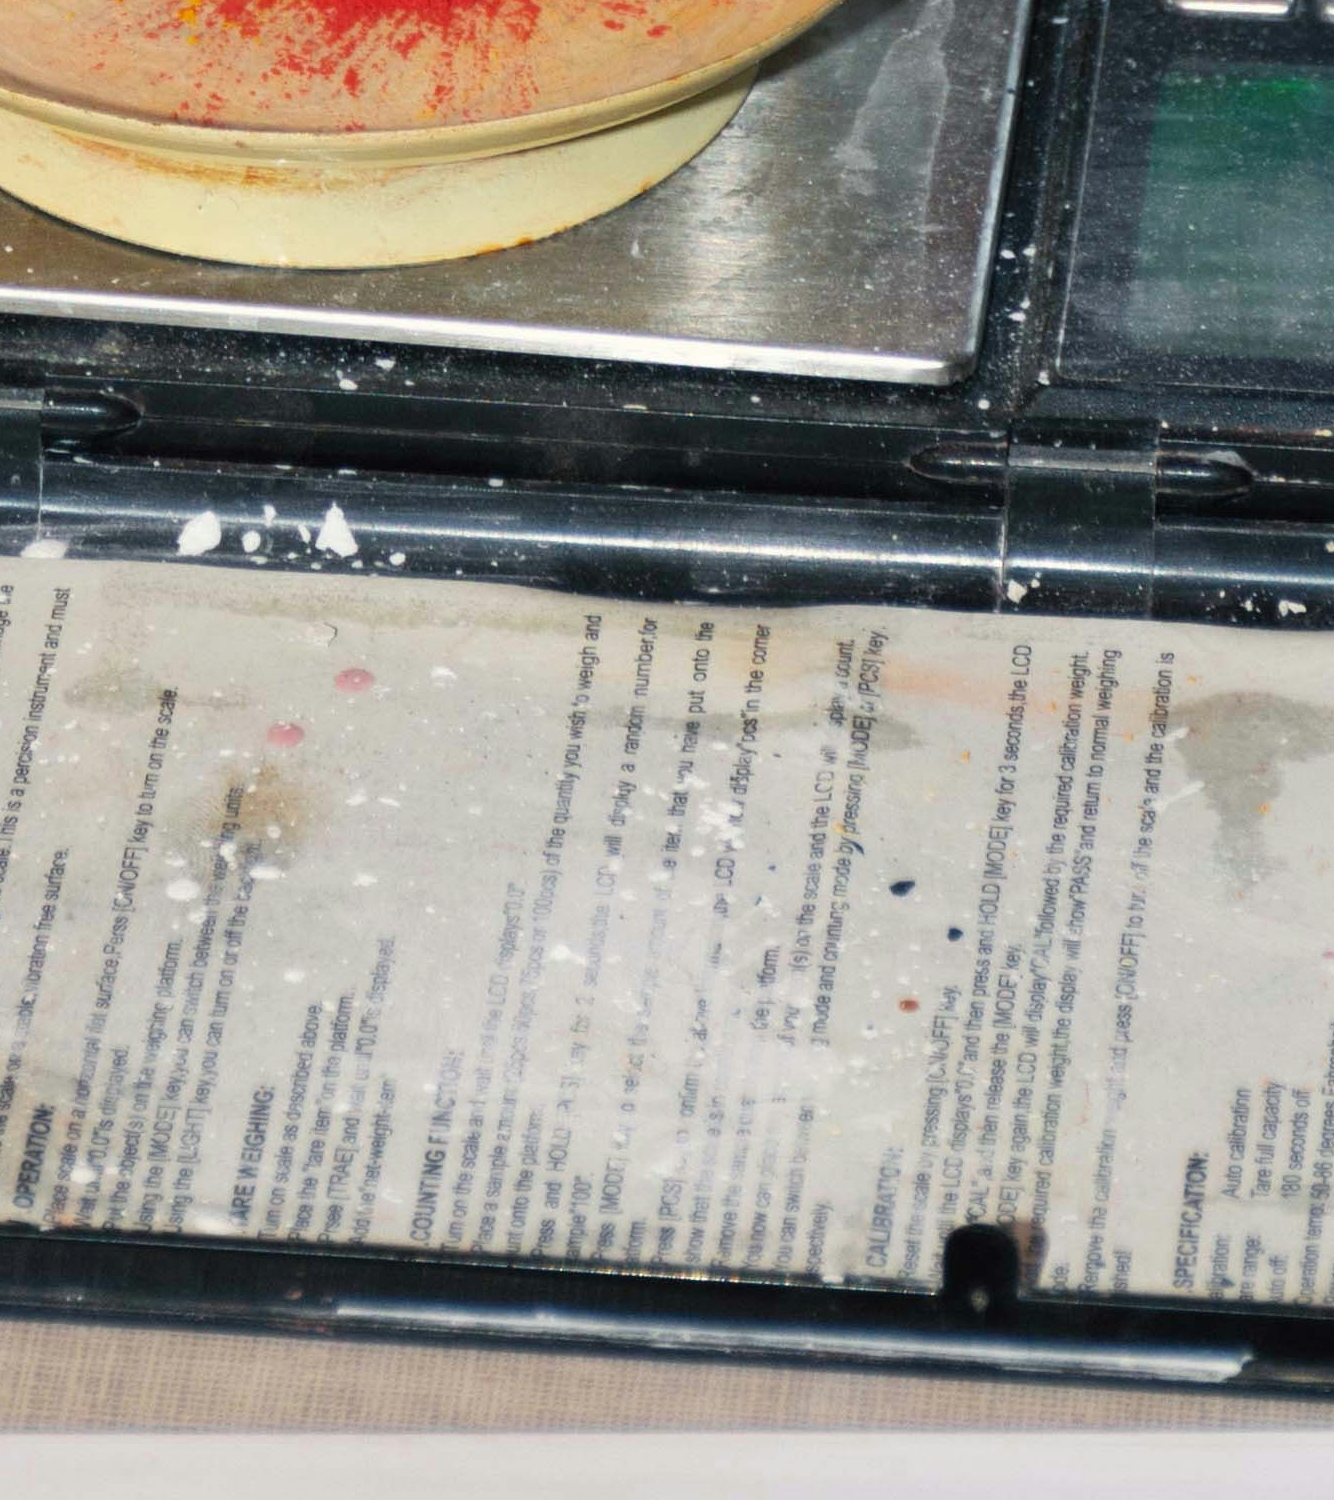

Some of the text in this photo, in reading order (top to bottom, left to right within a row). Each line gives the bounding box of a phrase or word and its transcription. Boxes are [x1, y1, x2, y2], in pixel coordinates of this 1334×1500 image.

[42, 623, 62, 649] and
[49, 587, 70, 620] must
[686, 648, 710, 713] put onto
[744, 624, 770, 693] the corner
[1096, 649, 1122, 710] weighing
[11, 725, 41, 784] percision
[545, 614, 602, 848] the quantity you wish weigh and
[621, 705, 643, 754] random
[1090, 715, 1109, 760] normal
[128, 727, 169, 843] key turn on the
[1082, 781, 1100, 820] return
[1086, 764, 1103, 777] to
[795, 805, 830, 925] the scale and the
[964, 644, 1032, 1030] then press HOLD [MODE] key for LCD
[830, 857, 850, 896] mode
[1017, 703, 1081, 1083] LCD will the required calibration
[33, 904, 56, 930] free
[1093, 651, 1175, 1201] calibration and the calibration is
[919, 1086, 947, 1146] pressing
[979, 1032, 1010, 1145] then release the
[1221, 1088, 1249, 1199] Auto calibration
[1252, 1081, 1285, 1196] Tare full capacity
[1282, 1088, 1310, 1198] 180 seconds off
